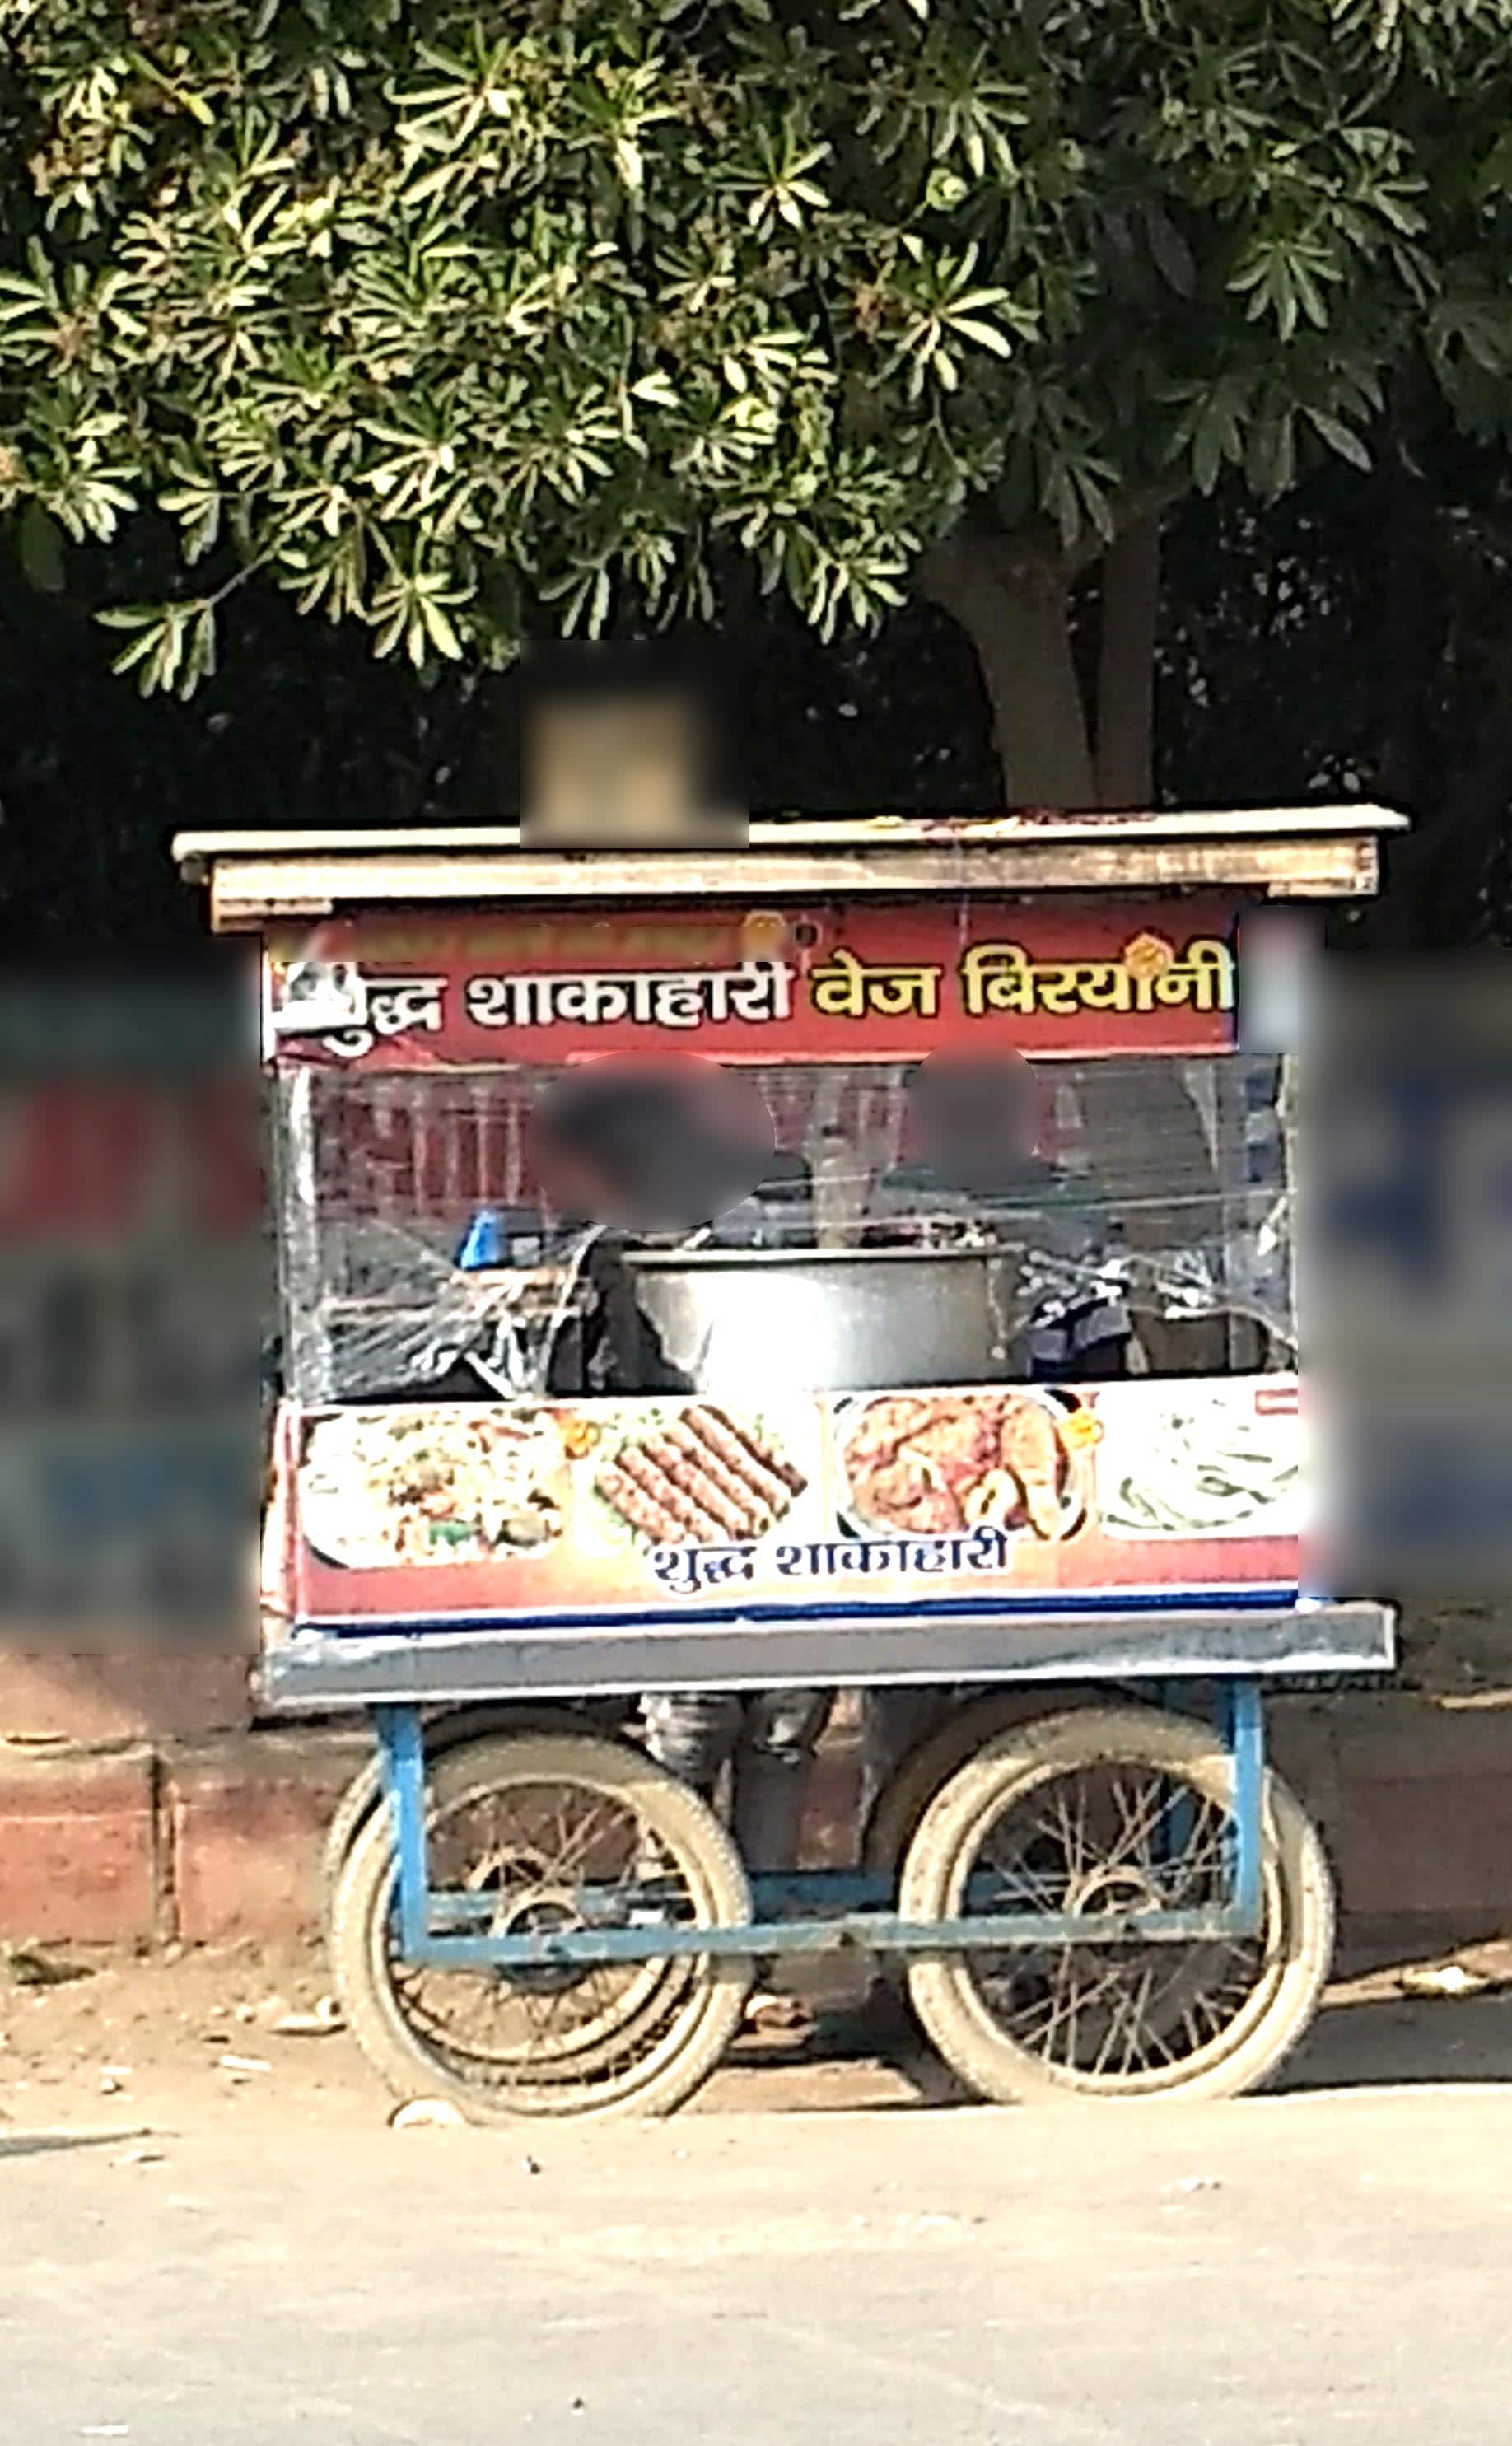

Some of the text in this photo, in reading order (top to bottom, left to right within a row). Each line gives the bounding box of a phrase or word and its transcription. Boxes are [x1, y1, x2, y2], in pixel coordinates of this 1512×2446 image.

[308, 972, 448, 1057] ुद्ध
[466, 960, 796, 1027] शाकाहारी
[811, 948, 941, 1017] वेज
[654, 1525, 1008, 1594] शुद्ध शाकाहारी
